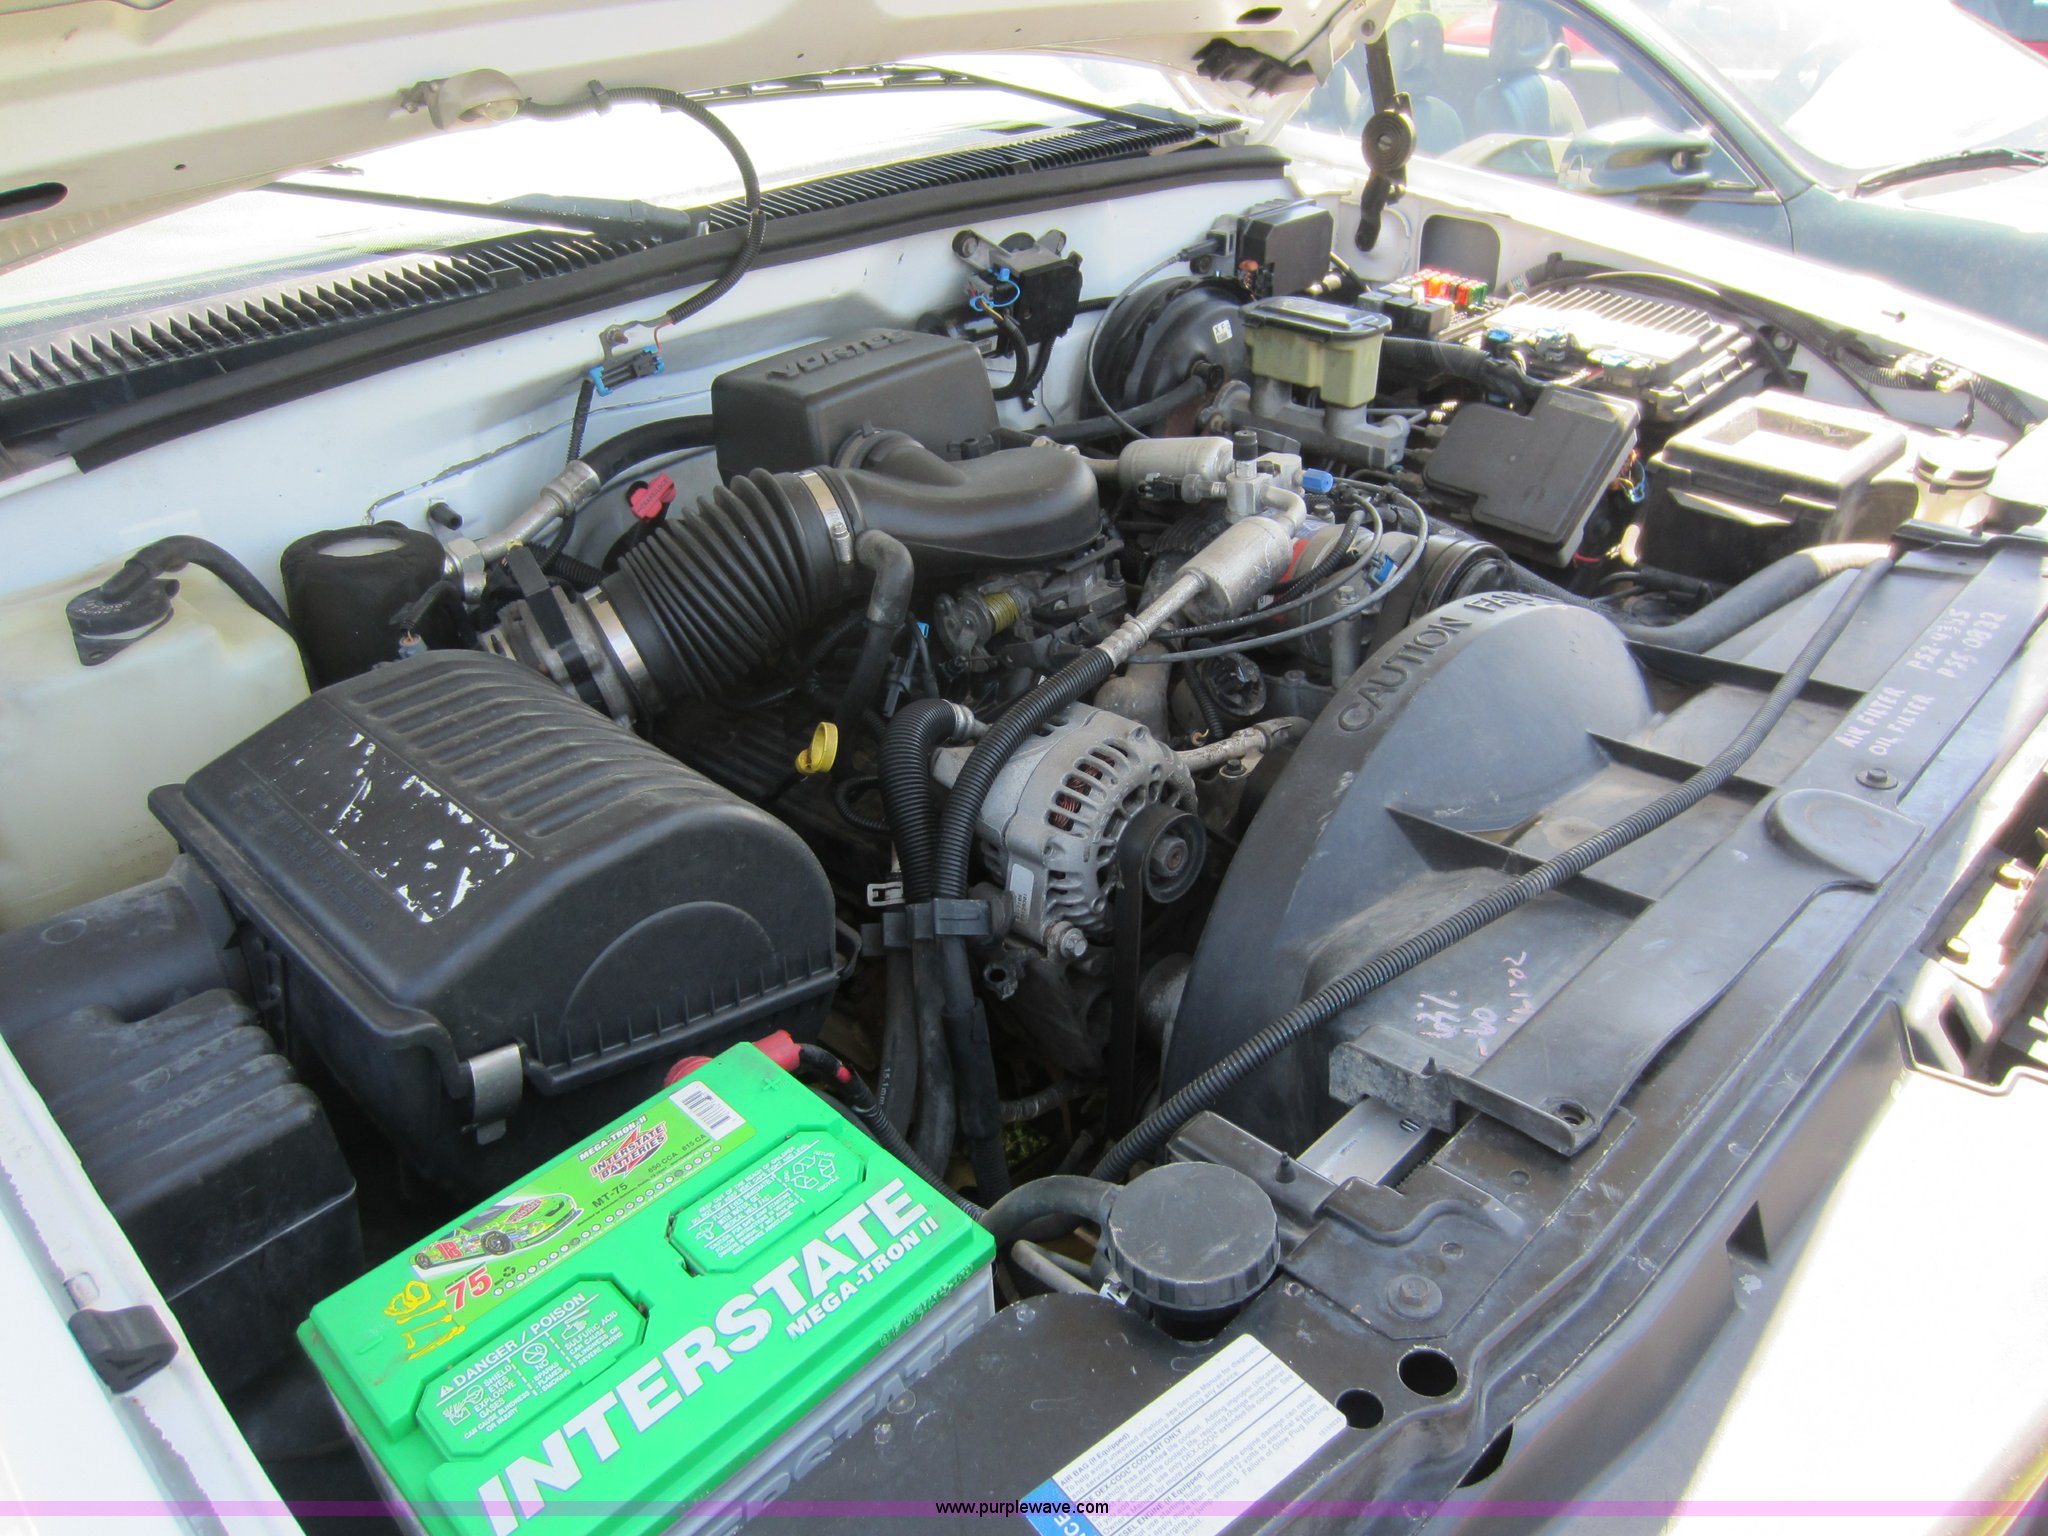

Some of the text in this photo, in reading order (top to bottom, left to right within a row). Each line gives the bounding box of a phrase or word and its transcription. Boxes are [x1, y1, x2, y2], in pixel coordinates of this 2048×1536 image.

[1338, 616, 1472, 732] CAUTION
[1835, 727, 1871, 748] AIR
[1857, 687, 1907, 726] FILTER
[1869, 737, 1904, 756] OIL
[1888, 694, 1935, 734] FILTER
[578, 1119, 637, 1162] MEGA-TRON
[591, 1123, 663, 1175] INTERSTATE
[600, 1132, 665, 1179] BATTERIES
[591, 1180, 628, 1209] MT-75
[660, 1150, 678, 1165] CCA
[694, 1132, 706, 1143] CA
[445, 1266, 492, 1311] 75
[785, 1231, 922, 1342] MEGA-TRON
[921, 1215, 940, 1245] II
[452, 1339, 518, 1386] DANGER
[529, 1292, 586, 1334] POISON
[564, 1310, 618, 1349] SULFURIC ACID
[569, 1328, 605, 1354] CAN CAUSE
[573, 1333, 609, 1359] BLINDNESS
[477, 1178, 928, 1536] INTERSTATE
[483, 1364, 512, 1386] SHIELD
[535, 1358, 549, 1370] NO
[537, 1366, 563, 1386] FLAMES
[577, 1345, 603, 1364] SEVERE
[473, 1380, 516, 1411] EXPLOSIVE
[487, 1375, 509, 1392] EYES
[540, 1368, 572, 1391] SMOKING
[464, 1427, 477, 1438] CAN
[497, 1390, 530, 1415] BLINDNESS
[479, 1397, 506, 1418] GASES
[1060, 1475, 1073, 1487] AIR
[1073, 1463, 1089, 1477] BAG
[1096, 1432, 1130, 1459] Equipped)
[1074, 1472, 1090, 1486] help
[1089, 1459, 1108, 1475] avoid
[1108, 1435, 1139, 1461] unwanted
[1085, 1468, 1110, 1488] service
[1110, 1439, 1148, 1470] procedures
[1148, 1423, 1170, 1441] before
[1169, 1397, 1204, 1425] performing
[1131, 1442, 1164, 1469] COOLANT
[1163, 1428, 1182, 1444] ONLY
[1136, 1502, 1164, 1525] ENGINE
[1171, 1470, 1205, 1498] Equipped)
